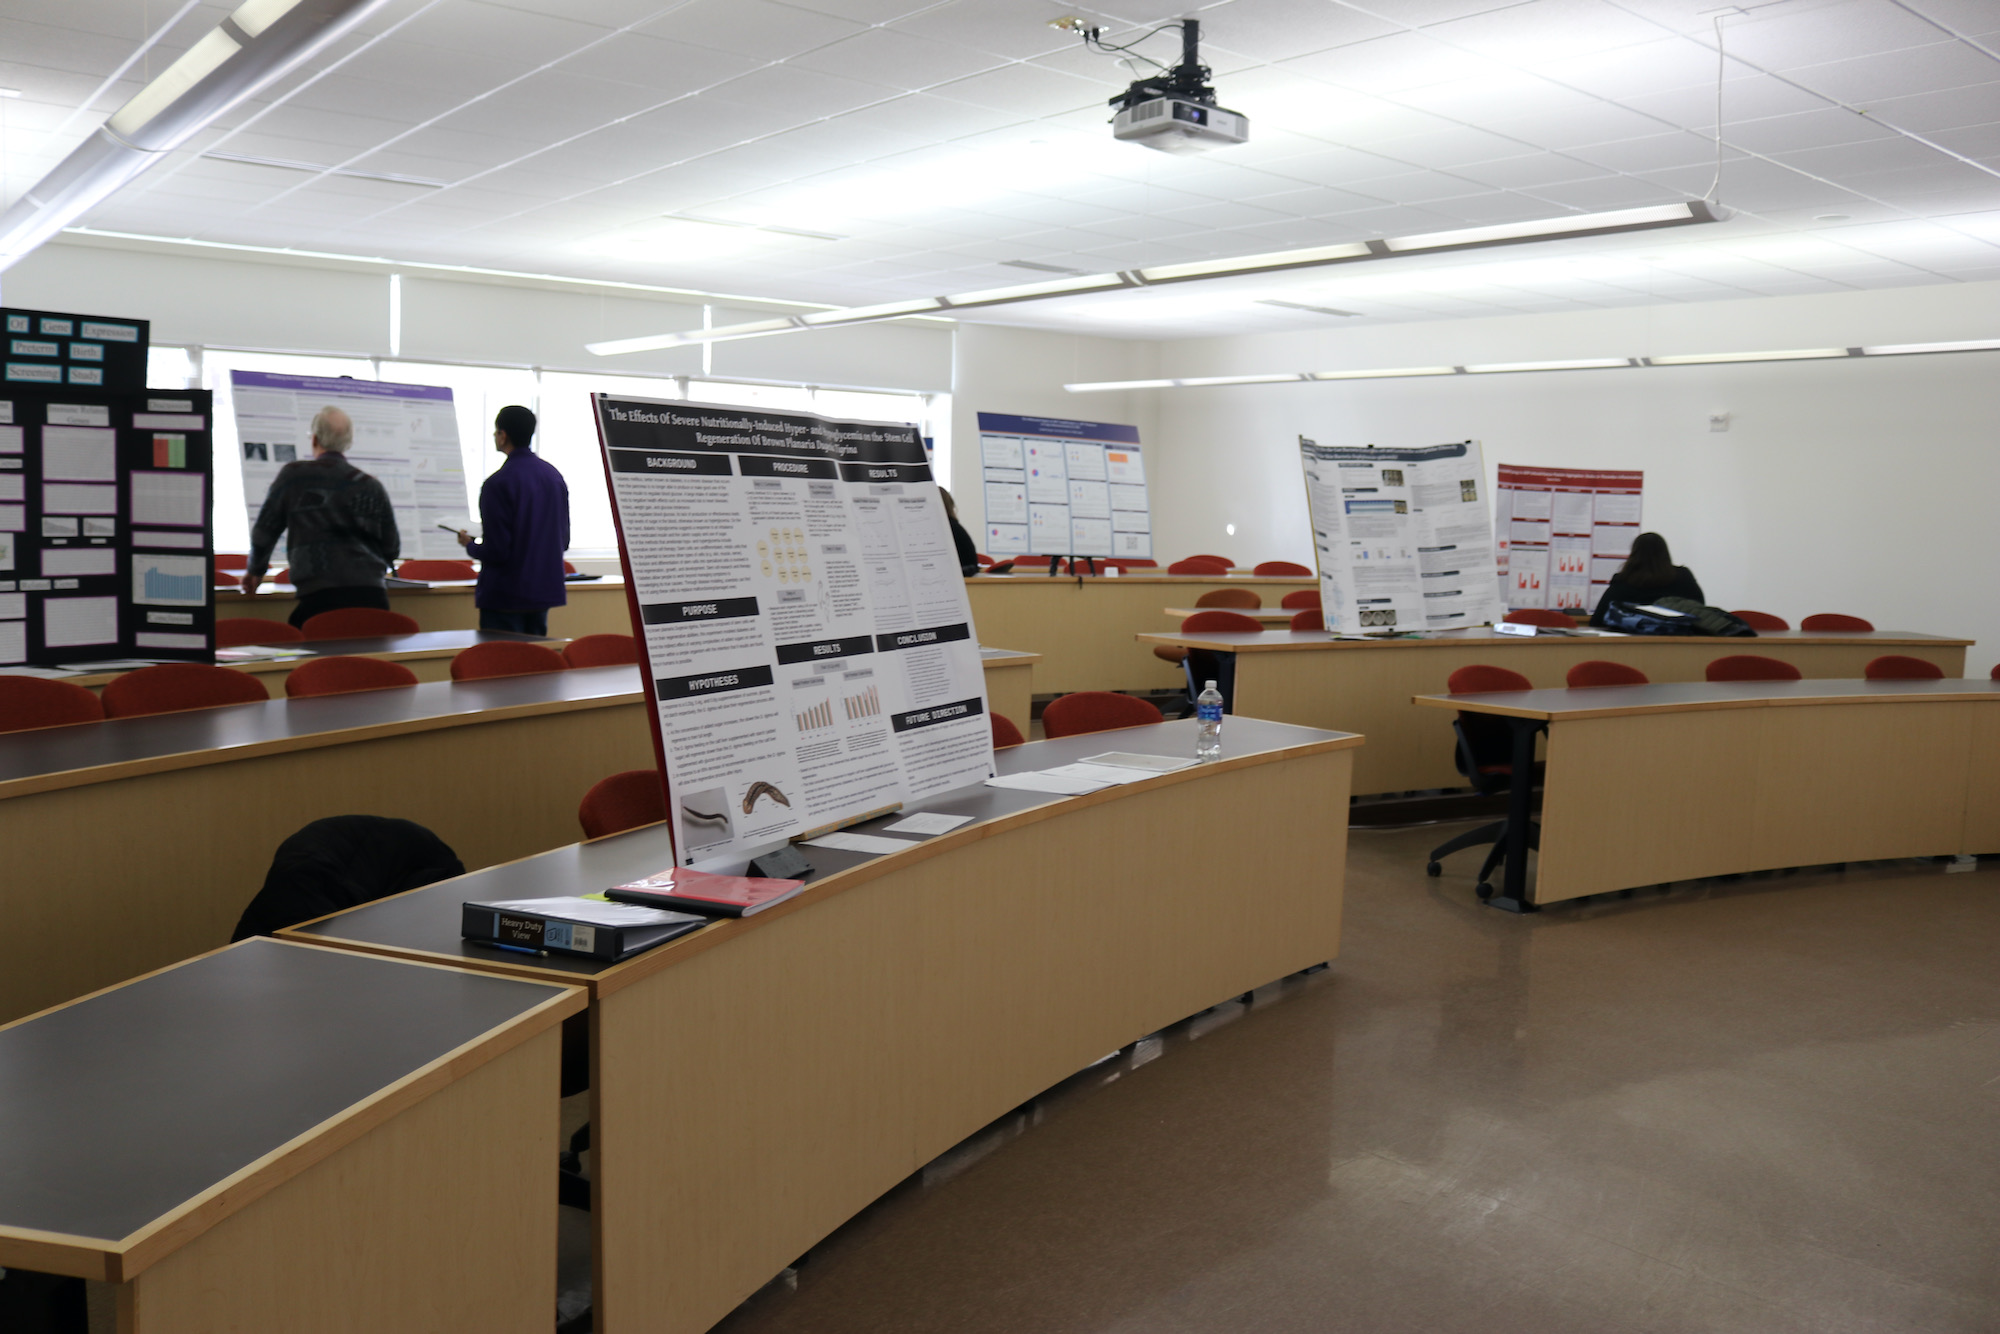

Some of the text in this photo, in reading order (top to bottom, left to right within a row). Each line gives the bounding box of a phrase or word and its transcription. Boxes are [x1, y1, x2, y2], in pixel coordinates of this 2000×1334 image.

[43, 322, 70, 333] Gene
[84, 324, 136, 338] Expression
[16, 342, 97, 357] Preterm Birth
[10, 366, 99, 382] Screening Study
[610, 408, 628, 421] The
[629, 410, 659, 424] Effects
[660, 414, 671, 425] Of
[672, 414, 700, 426] Severe
[701, 416, 783, 432] Nutritionally-Induced
[784, 423, 809, 436] Hyper-
[811, 425, 823, 435] and
[871, 431, 884, 442] the
[884, 432, 902, 442] Stem
[696, 432, 751, 446] Regeneration
[752, 434, 761, 445] Of
[762, 436, 785, 447] Brown
[786, 437, 816, 449] Planaria
[646, 457, 697, 469] BACKGROUND
[773, 462, 809, 474] PROCEDURE
[868, 469, 898, 479] RESULTS
[682, 604, 718, 616] PURPOSE
[897, 631, 938, 645] CONCLUSION
[813, 643, 841, 655] RESULTS
[688, 674, 740, 691] HYPOTHESES
[905, 704, 968, 725] FUTURE DIRECTION
[501, 917, 544, 933] Heavy Duty
[512, 930, 531, 940] View
